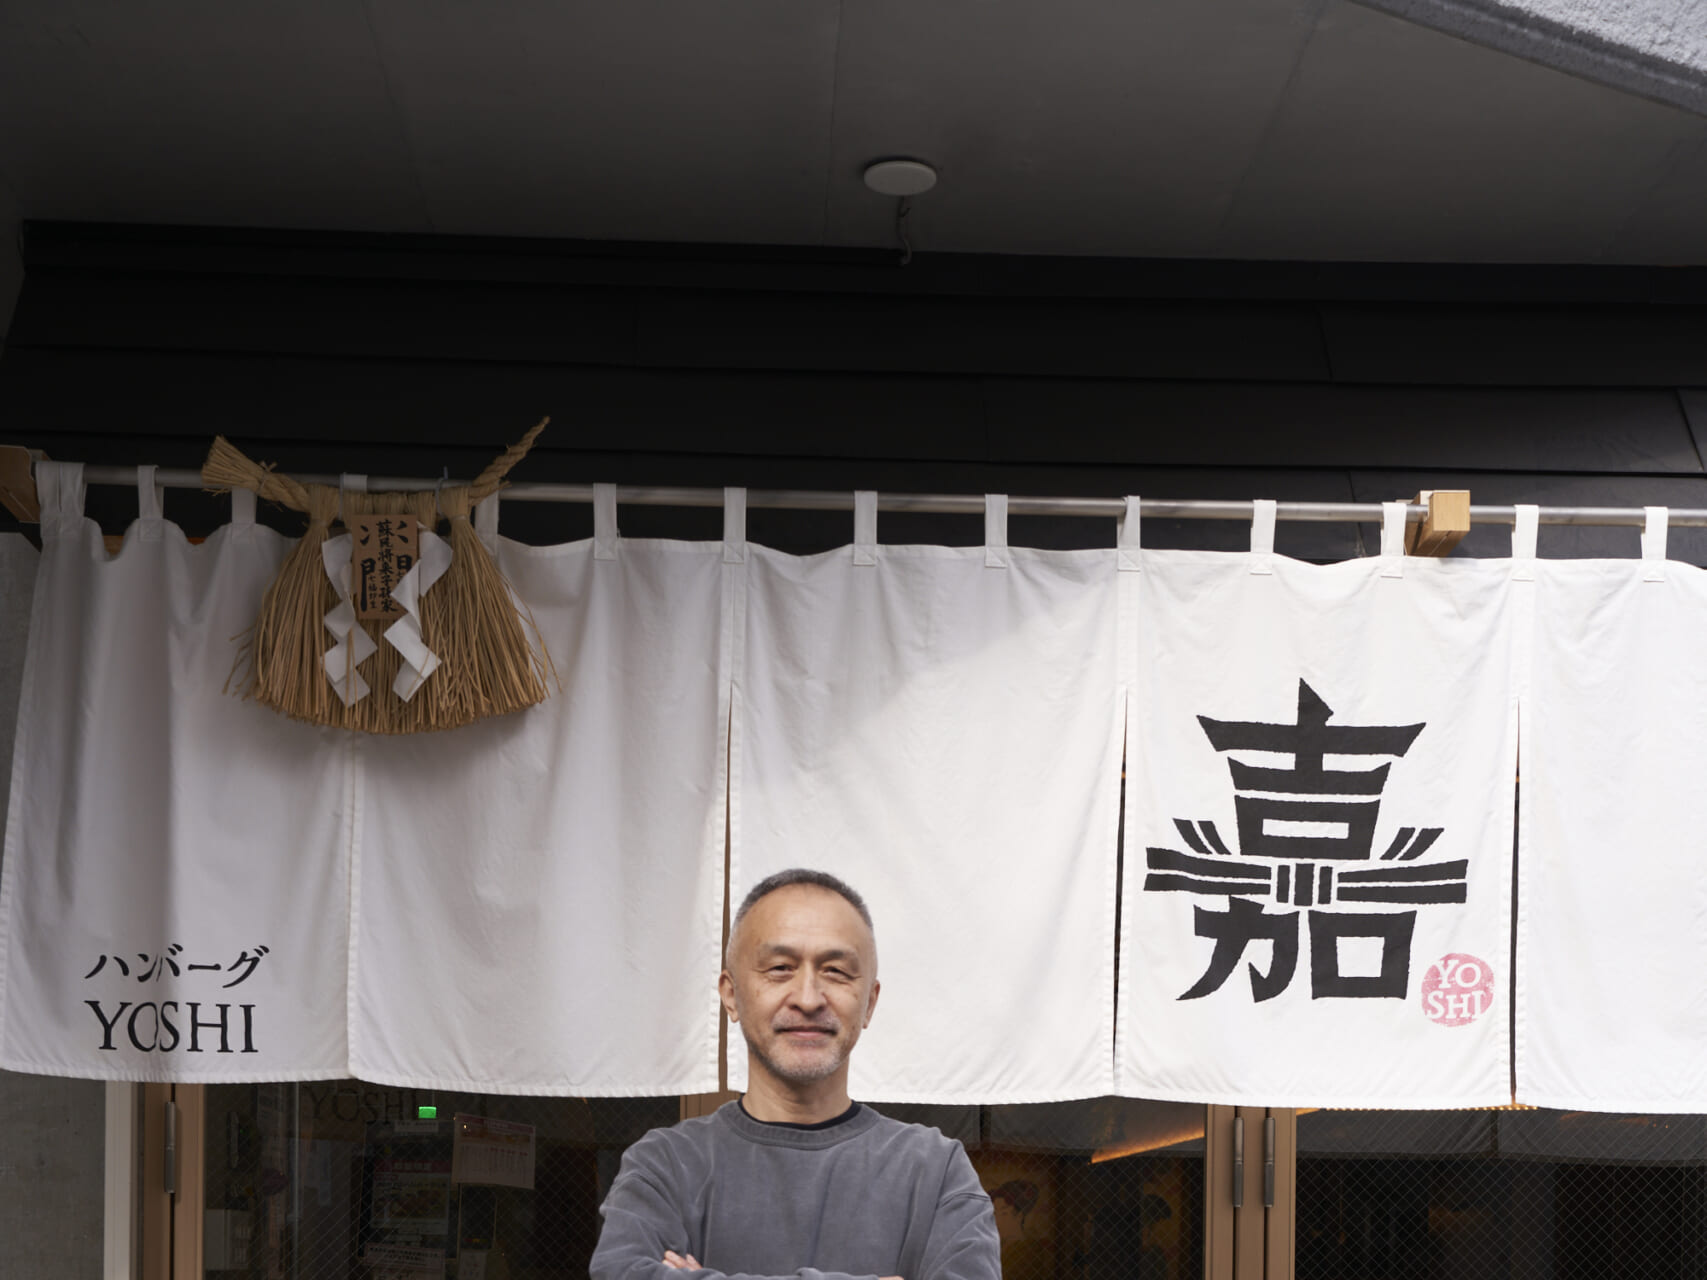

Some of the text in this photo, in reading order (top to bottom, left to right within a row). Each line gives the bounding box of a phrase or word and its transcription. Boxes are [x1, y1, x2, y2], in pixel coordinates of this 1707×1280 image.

[1144, 677, 1469, 1003] 嘉
[84, 943, 270, 989] ハンバーグ
[1437, 958, 1481, 989] YO
[84, 1000, 259, 1053] YOSHI
[1427, 989, 1486, 1021] SHI
